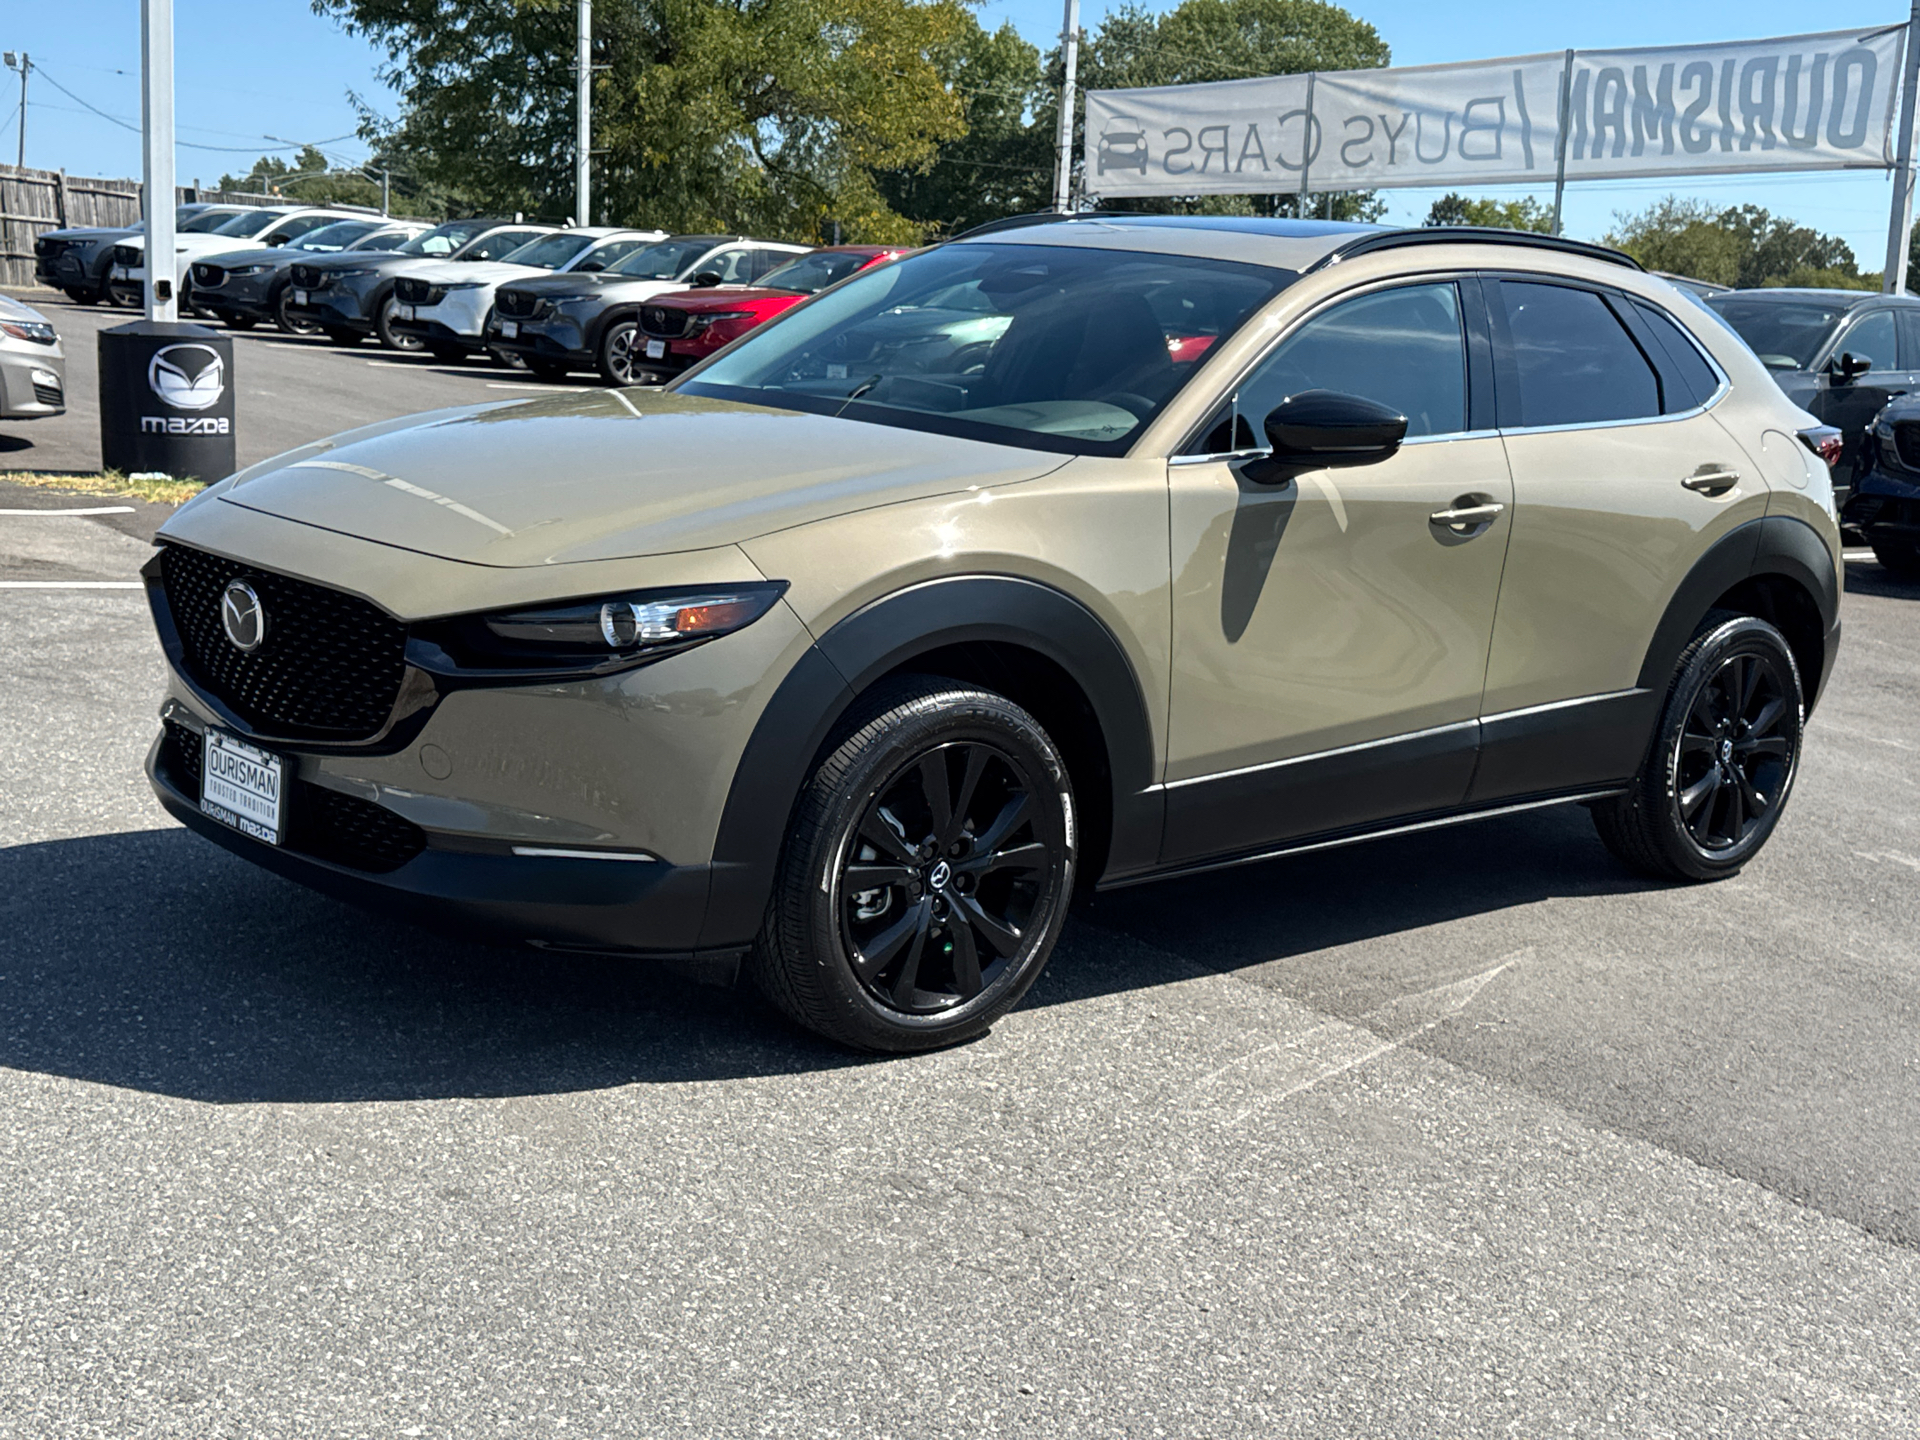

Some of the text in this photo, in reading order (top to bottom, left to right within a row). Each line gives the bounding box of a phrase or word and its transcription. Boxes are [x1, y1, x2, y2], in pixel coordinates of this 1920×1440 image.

[211, 749, 276, 798] OURISMAN
[201, 799, 237, 827] OURISMAN
[210, 779, 275, 821] TRUSTED TRADITION
